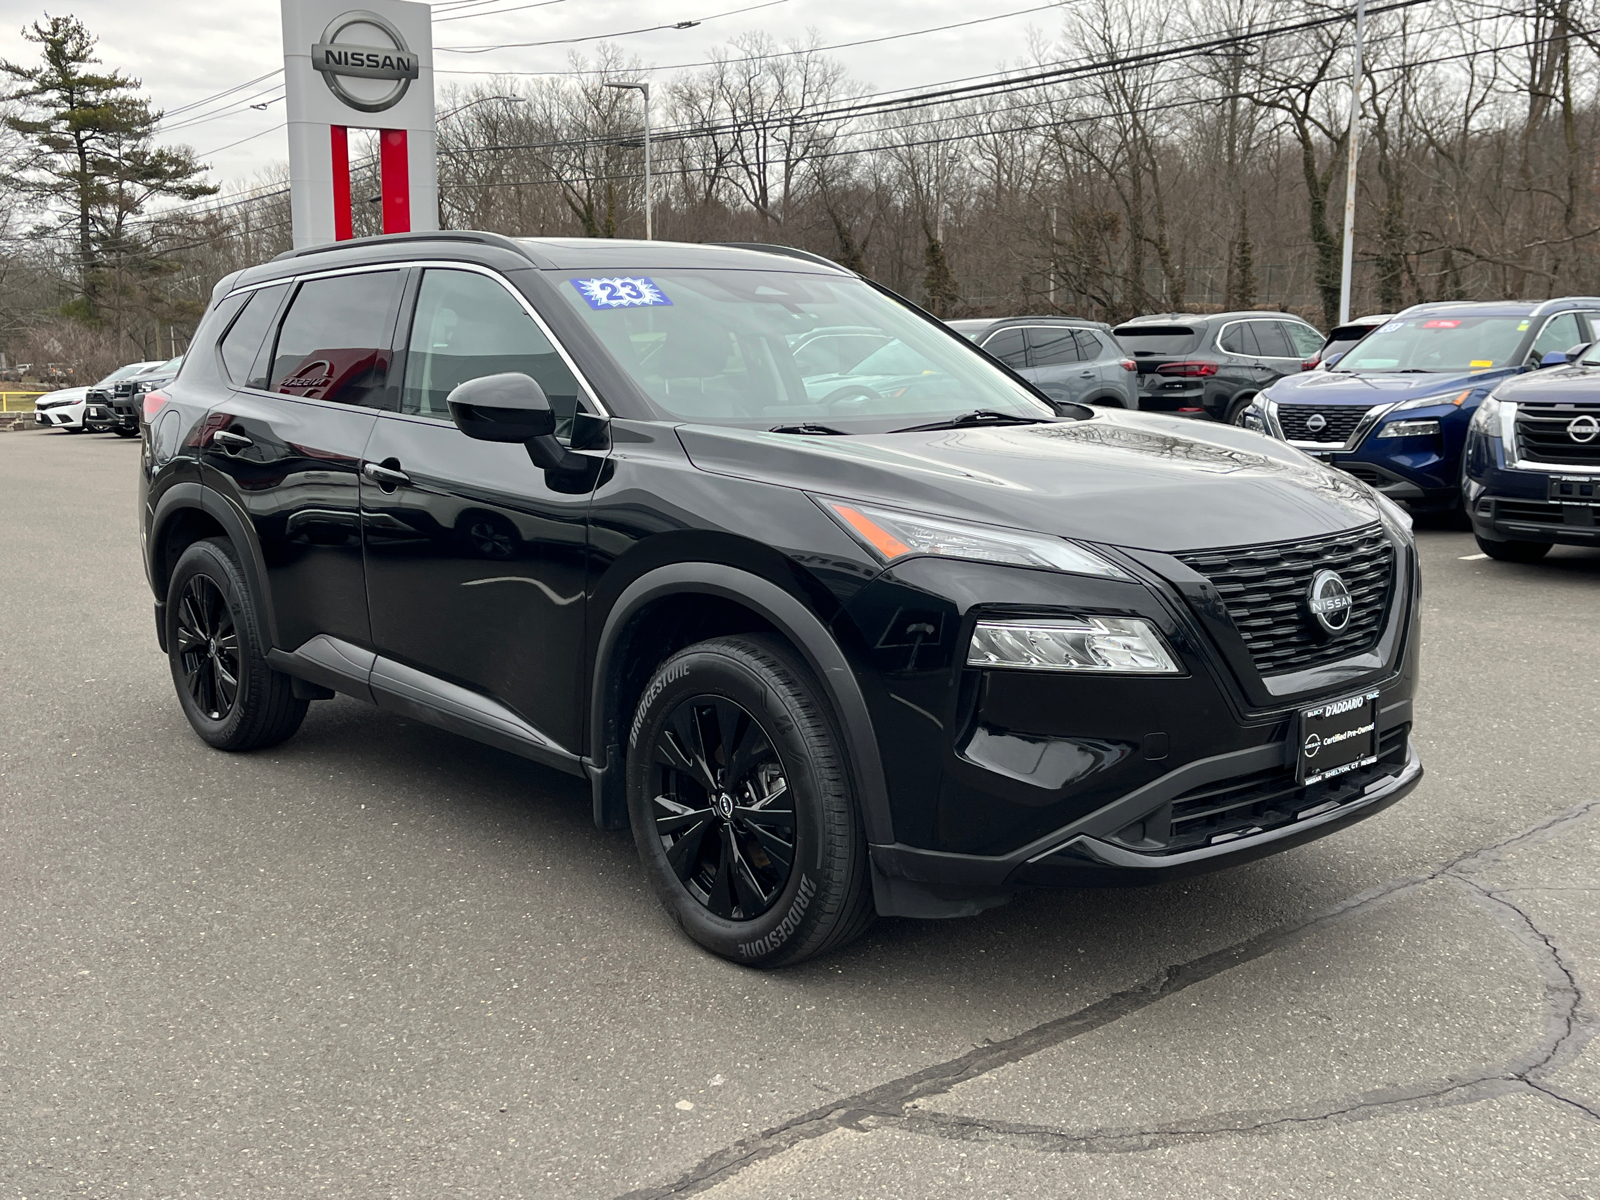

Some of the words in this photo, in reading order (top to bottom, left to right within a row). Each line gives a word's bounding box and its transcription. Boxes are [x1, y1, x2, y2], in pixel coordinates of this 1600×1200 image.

[325, 50, 410, 71] NISSAN
[599, 282, 643, 300] 23
[1312, 595, 1352, 611] NISSAN
[629, 663, 690, 749] BRIDGESTONE
[1325, 697, 1363, 717] D'ADDARIO
[1323, 731, 1347, 746] Certified
[1347, 722, 1374, 739] Pre-Owned
[738, 873, 817, 957] BRIDGESTONE
